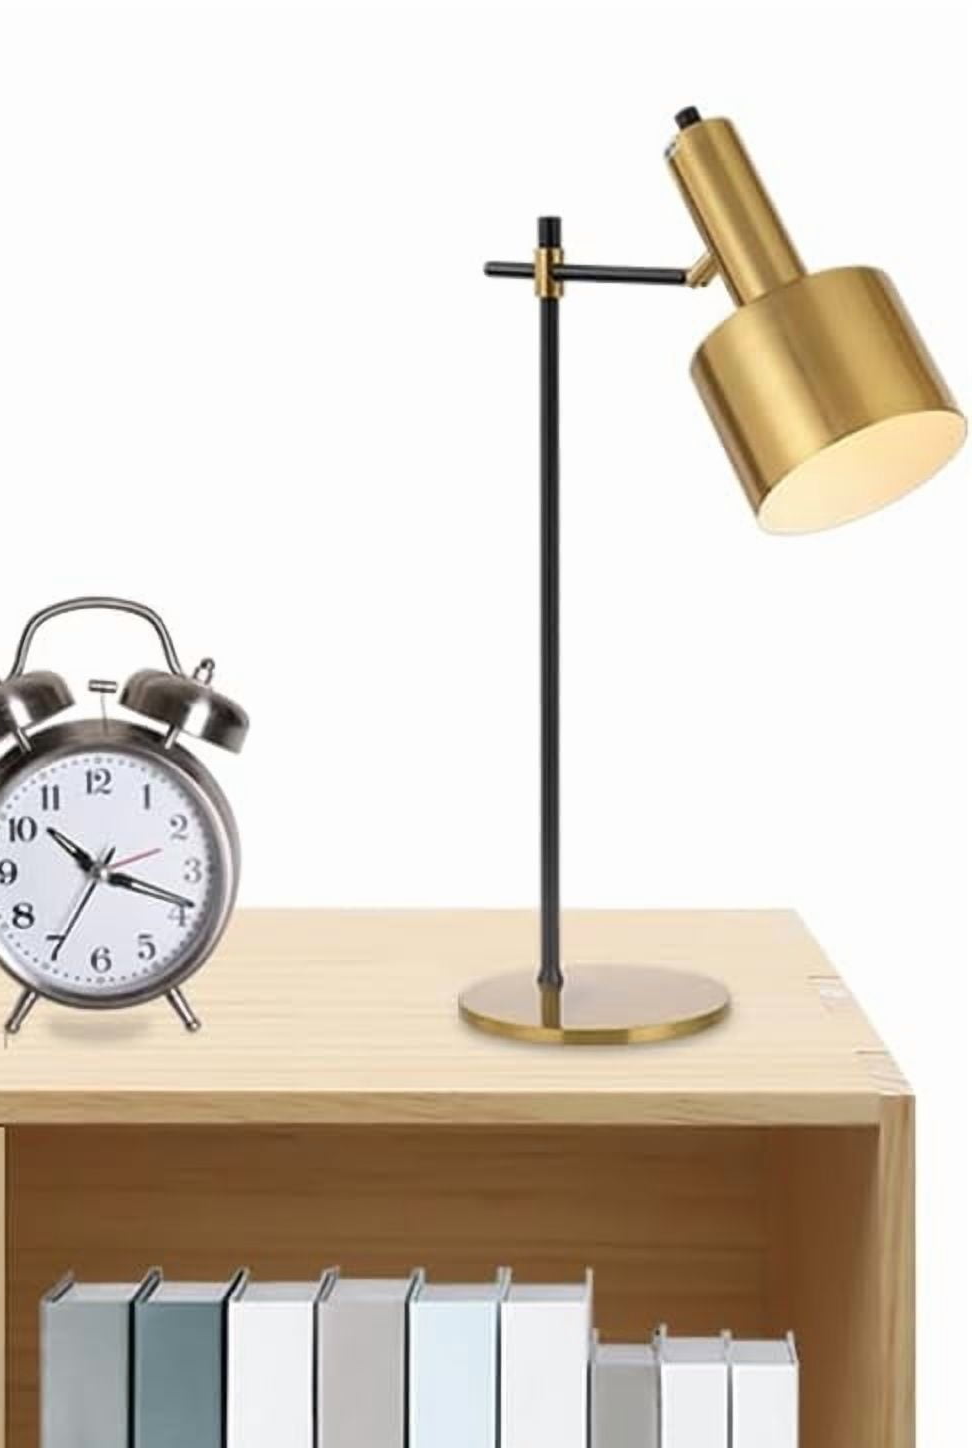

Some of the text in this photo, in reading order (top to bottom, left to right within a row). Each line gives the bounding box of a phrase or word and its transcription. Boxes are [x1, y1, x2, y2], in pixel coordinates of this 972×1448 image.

[85, 768, 112, 796] 12
[40, 784, 60, 811] 11
[142, 784, 152, 810] 1
[8, 816, 38, 842] 10
[170, 814, 188, 840] 2
[184, 859, 202, 883] 3
[12, 903, 35, 930] 8
[168, 902, 193, 926] 4
[46, 934, 67, 962] 7
[90, 947, 112, 973] 6
[138, 934, 156, 961] 5
